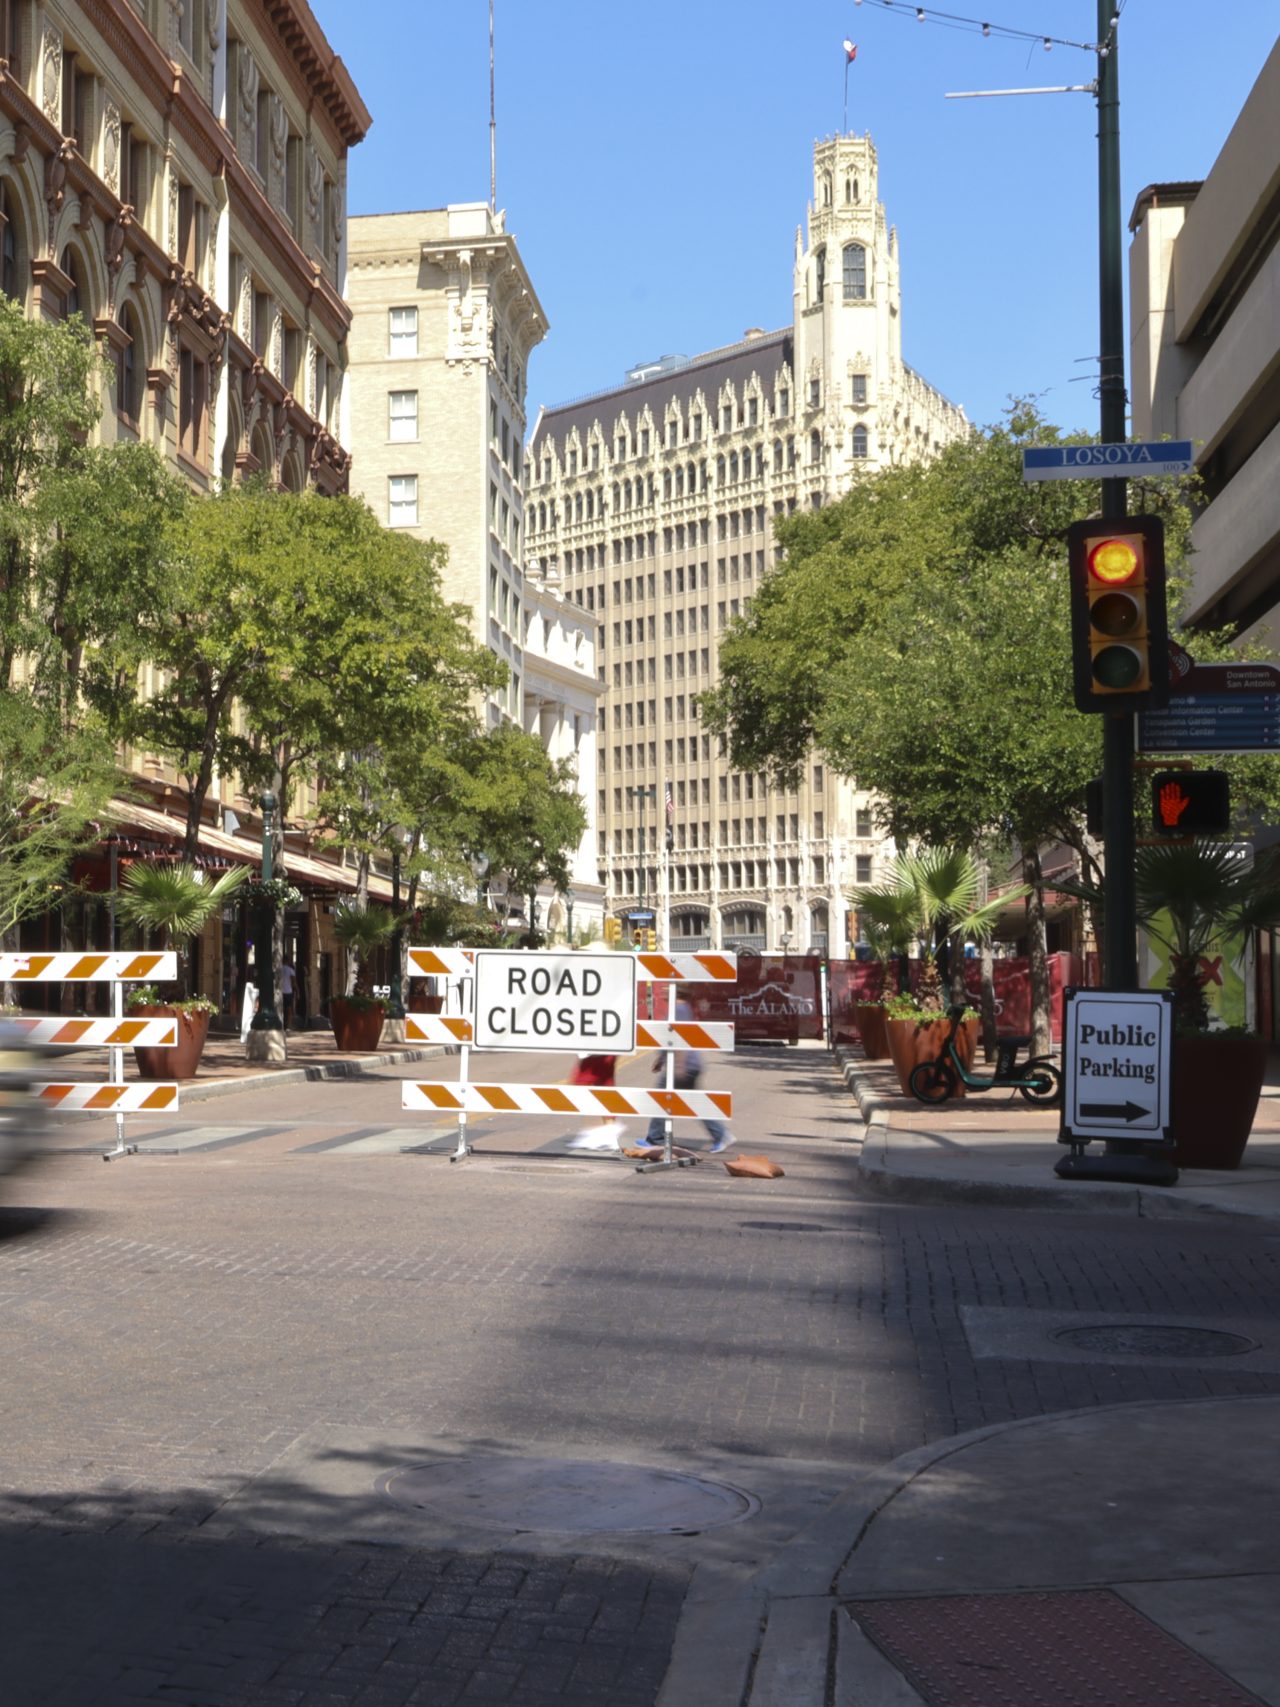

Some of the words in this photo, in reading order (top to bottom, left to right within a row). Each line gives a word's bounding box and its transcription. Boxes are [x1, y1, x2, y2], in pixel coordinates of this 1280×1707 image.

[1060, 446, 1154, 466] LOSOYA
[1226, 671, 1271, 679] Downtown
[1226, 680, 1243, 689] San
[1244, 680, 1277, 689] Antonio
[1171, 706, 1216, 715] Information
[1218, 705, 1244, 714] Center
[1188, 717, 1217, 726] Garden
[1189, 727, 1216, 736] Center
[507, 967, 603, 997] ROAD
[729, 1002, 754, 1016] The
[756, 999, 815, 1016] ALAMO
[487, 1006, 623, 1038] CLOSED
[1080, 1023, 1157, 1048] Public
[1079, 1056, 1156, 1085] Parking
